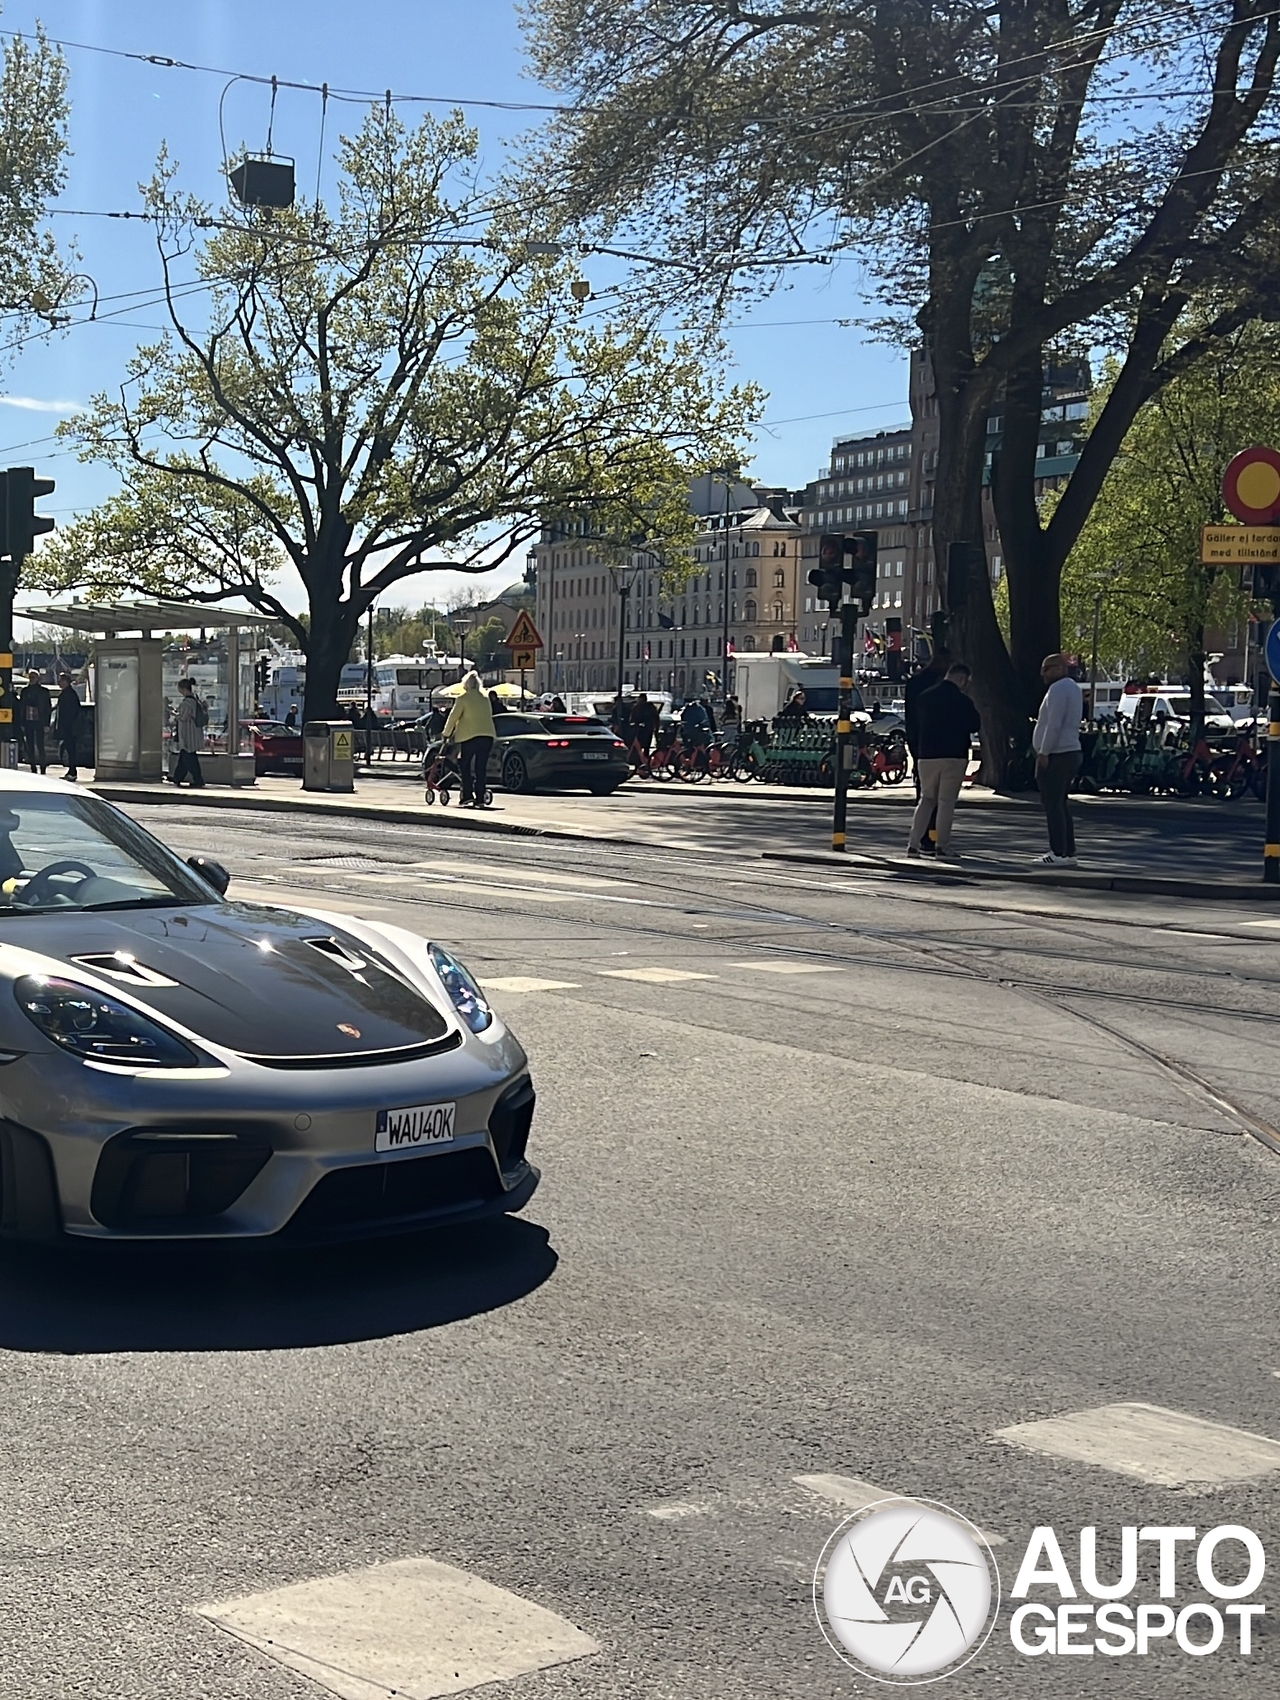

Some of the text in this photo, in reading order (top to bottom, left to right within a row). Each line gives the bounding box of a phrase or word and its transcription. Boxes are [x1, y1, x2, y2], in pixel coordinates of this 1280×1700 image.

[1206, 533, 1280, 544] Gäller ej fordo
[1210, 548, 1278, 557] med tillstånd
[388, 1107, 454, 1146] WAU40K
